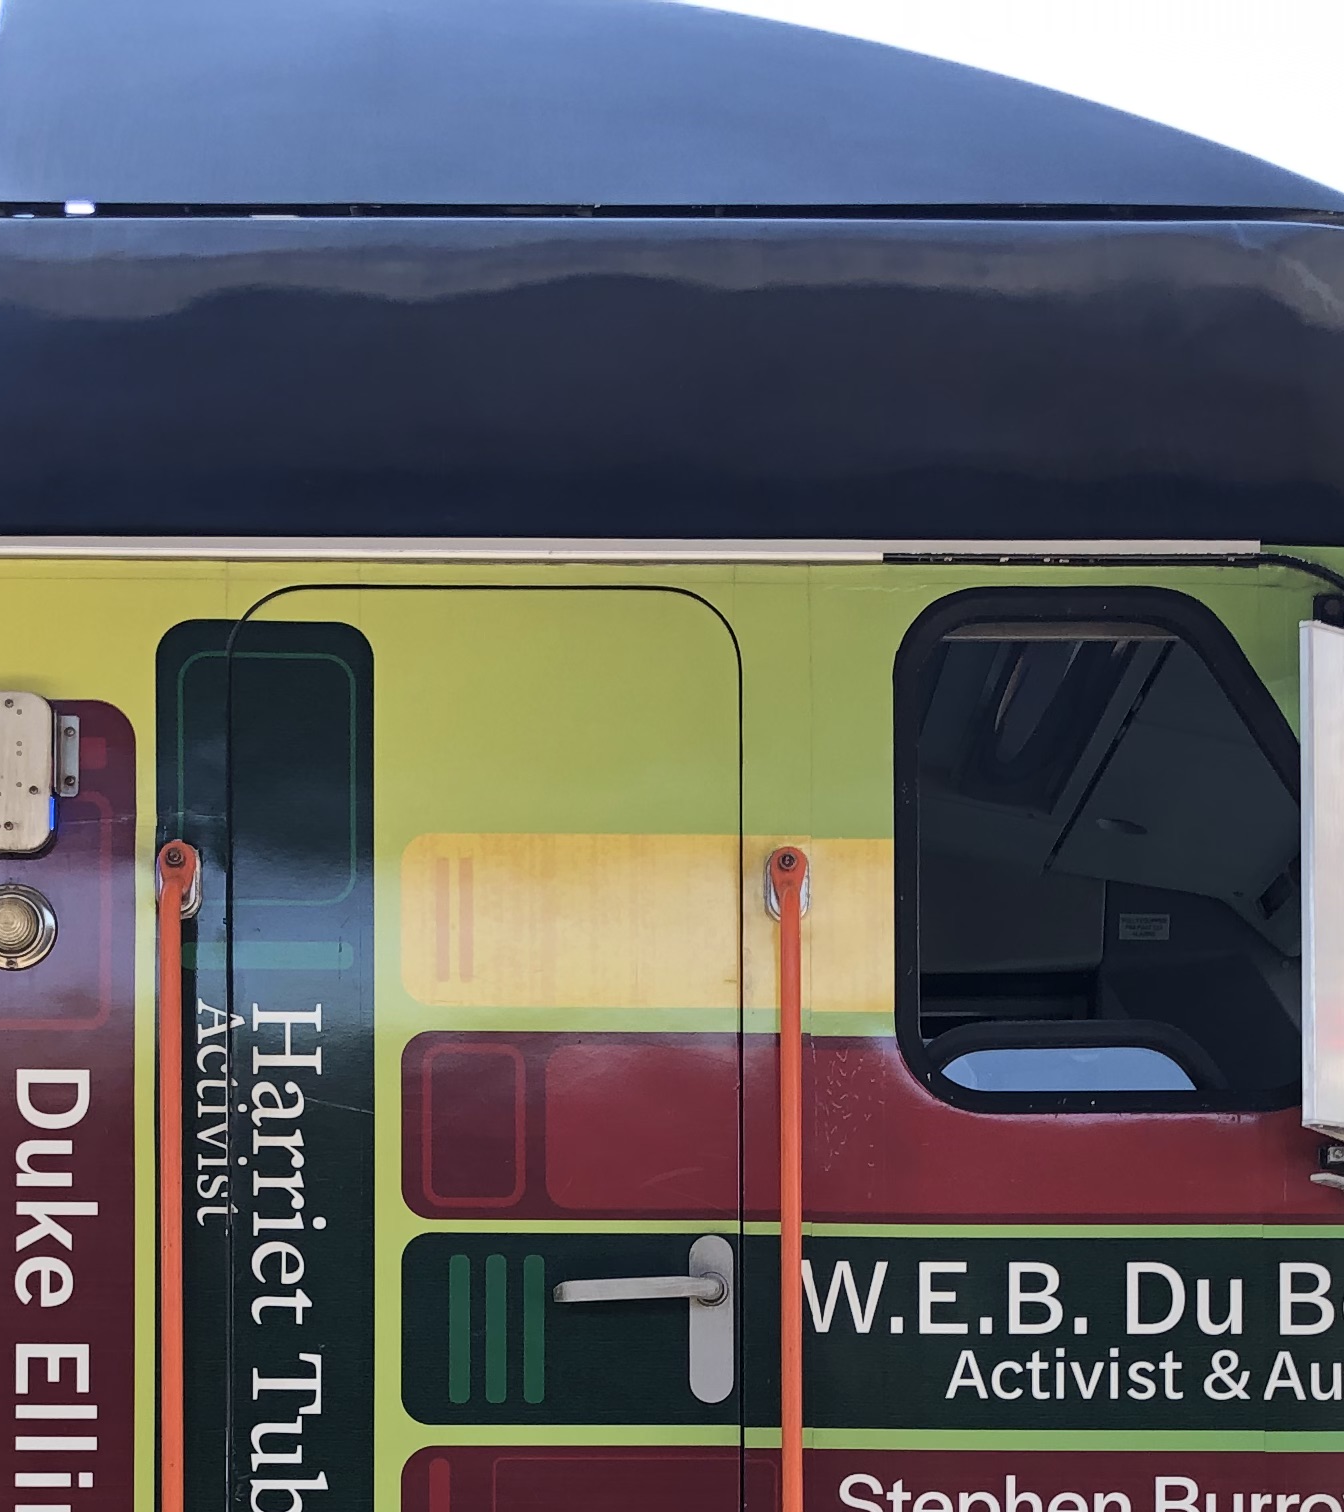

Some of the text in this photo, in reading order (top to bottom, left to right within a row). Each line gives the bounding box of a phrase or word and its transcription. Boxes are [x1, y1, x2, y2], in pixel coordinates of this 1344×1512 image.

[14, 1068, 99, 1308] Duke
[196, 997, 248, 1227] Activist
[250, 1002, 327, 1325] Harriet
[800, 1259, 1088, 1335] W.E.B.
[1126, 1261, 1243, 1336] Du
[944, 1347, 1184, 1400] Activist
[1203, 1349, 1251, 1401] &
